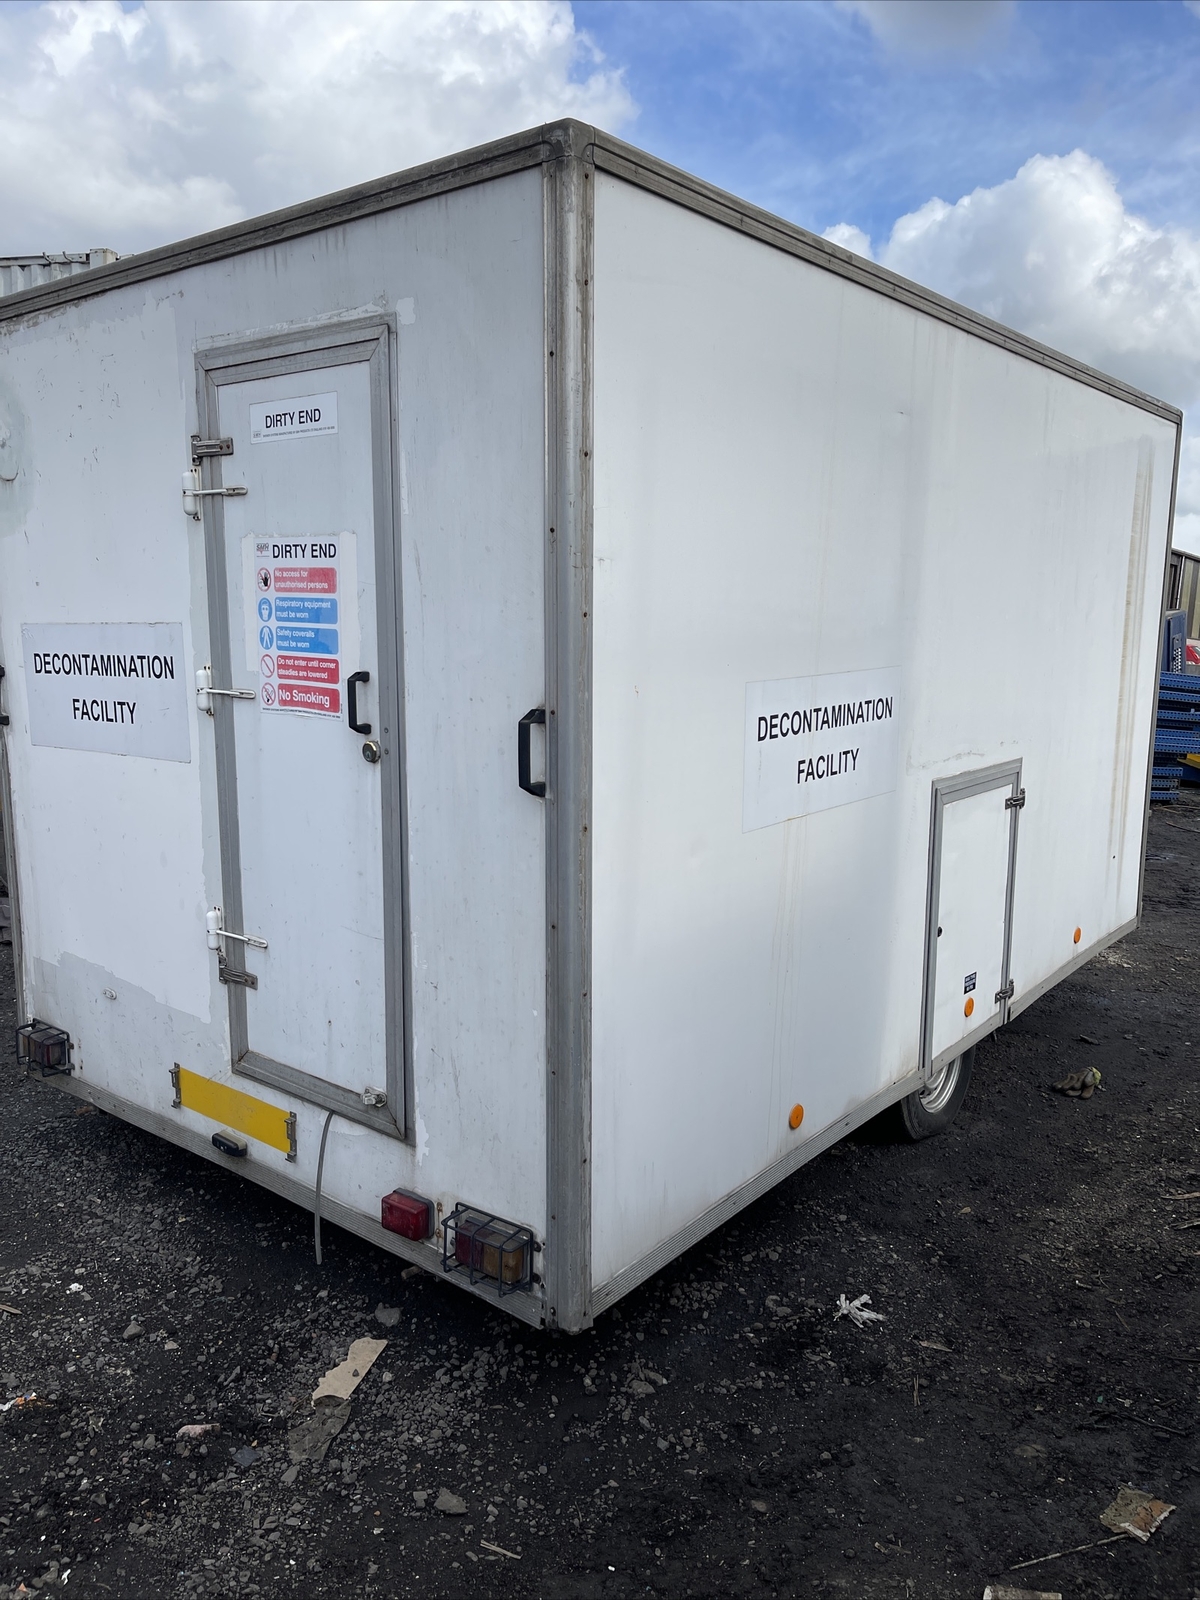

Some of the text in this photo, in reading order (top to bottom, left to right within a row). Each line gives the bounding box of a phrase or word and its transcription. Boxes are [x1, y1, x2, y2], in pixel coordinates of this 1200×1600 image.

[265, 408, 321, 429] DIRTY END
[272, 543, 337, 559] DIRTY END
[307, 582, 328, 590] persons
[276, 600, 331, 609] Respiratory equipment
[277, 629, 315, 638] Safety coveralls
[34, 653, 175, 679] DECONTAMINATION
[308, 671, 328, 679] lowered
[279, 689, 330, 708] No Smoking
[72, 699, 136, 724] FACILITY
[758, 696, 893, 742] DECONTAMINATION
[797, 748, 859, 784] FACILITY
